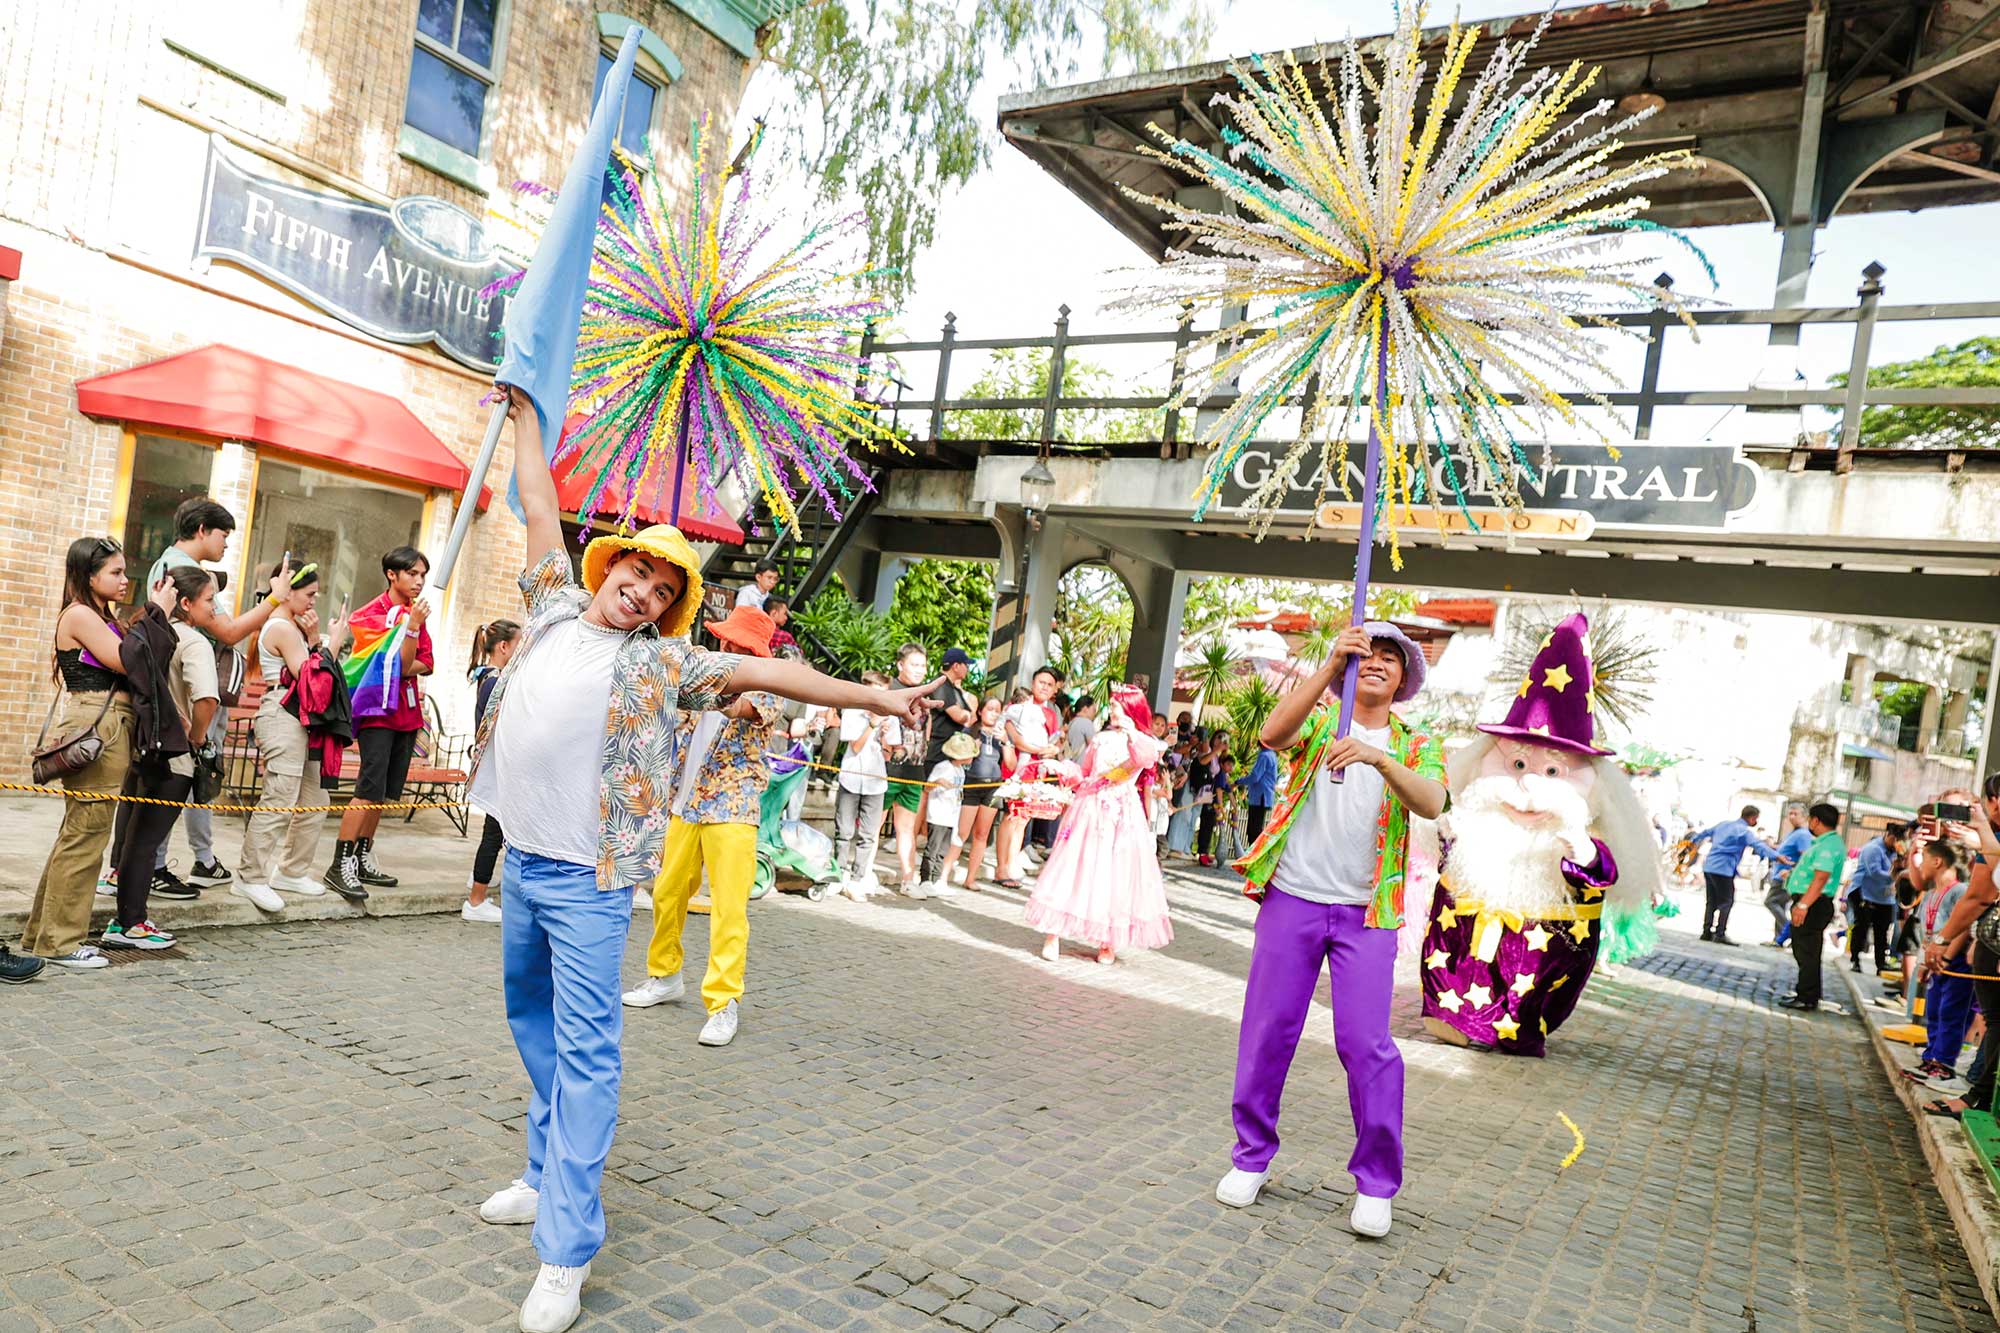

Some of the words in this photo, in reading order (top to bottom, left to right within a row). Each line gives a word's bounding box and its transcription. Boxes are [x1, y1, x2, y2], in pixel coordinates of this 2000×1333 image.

[241, 190, 352, 270] FIFTH
[363, 245, 492, 322] AVENUE
[1331, 509, 1577, 532] SATION
[711, 592, 726, 608] NO
